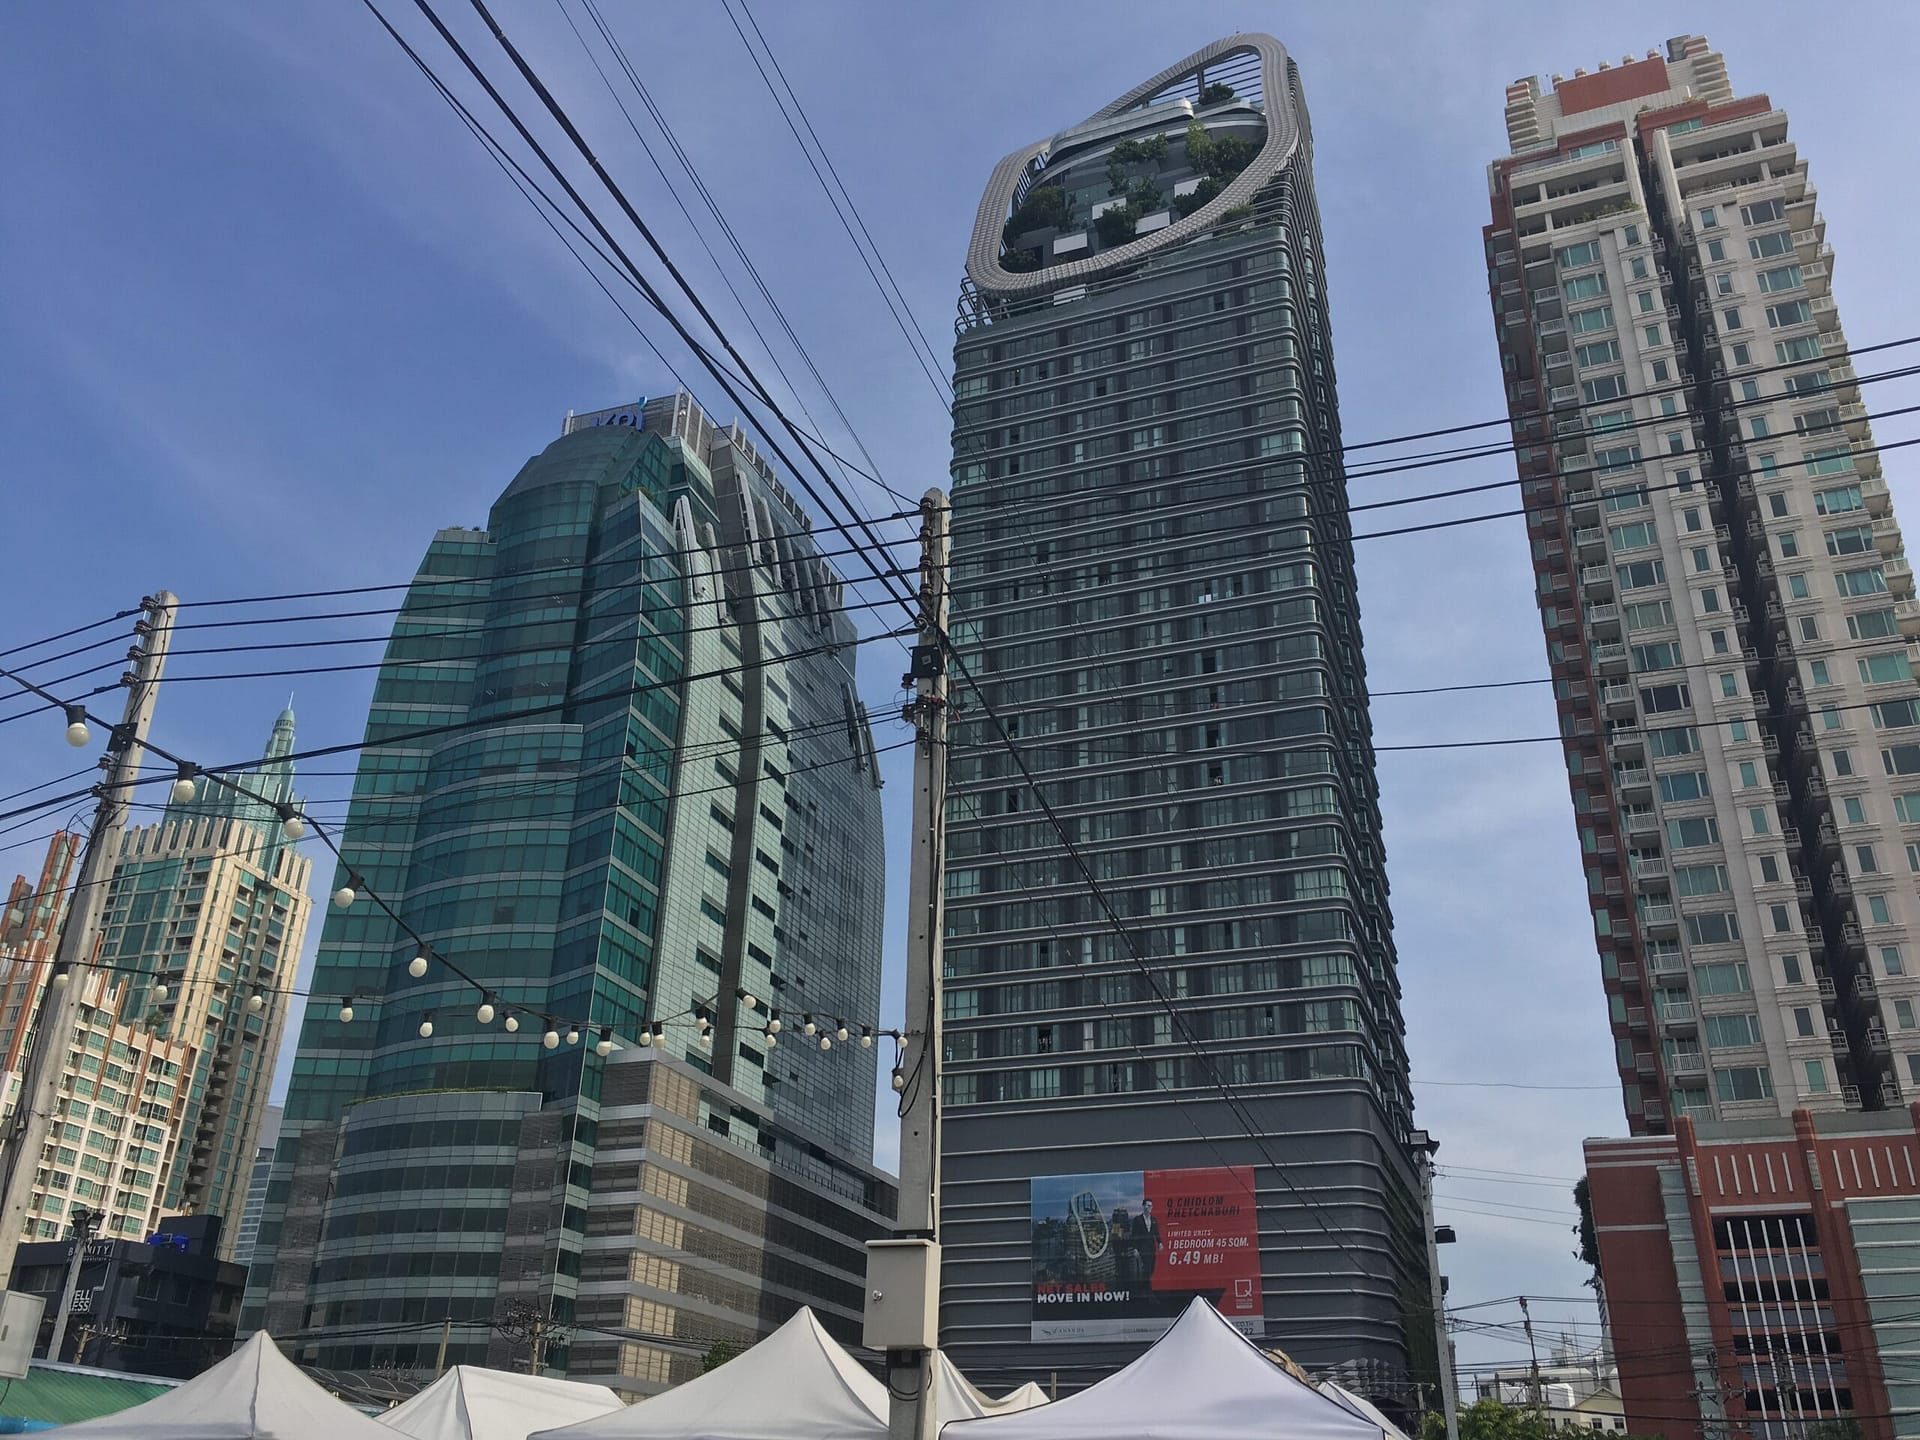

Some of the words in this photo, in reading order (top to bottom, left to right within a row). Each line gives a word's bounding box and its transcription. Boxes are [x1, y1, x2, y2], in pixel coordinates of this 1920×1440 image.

[1177, 1195, 1224, 1208] CHIDLOM
[1167, 1205, 1240, 1218] PHETCHABURI
[1173, 1238, 1214, 1249] BEDROOM
[1216, 1237, 1227, 1248] 45
[1228, 1236, 1249, 1248] SQM.
[1169, 1250, 1201, 1266] 6.49
[1203, 1254, 1224, 1265] MB!
[74, 1289, 90, 1301] ELL
[1037, 1293, 1073, 1304] MOVE
[1077, 1292, 1091, 1303] IN
[1094, 1291, 1130, 1302] NOW!
[71, 1300, 90, 1312] ESS
